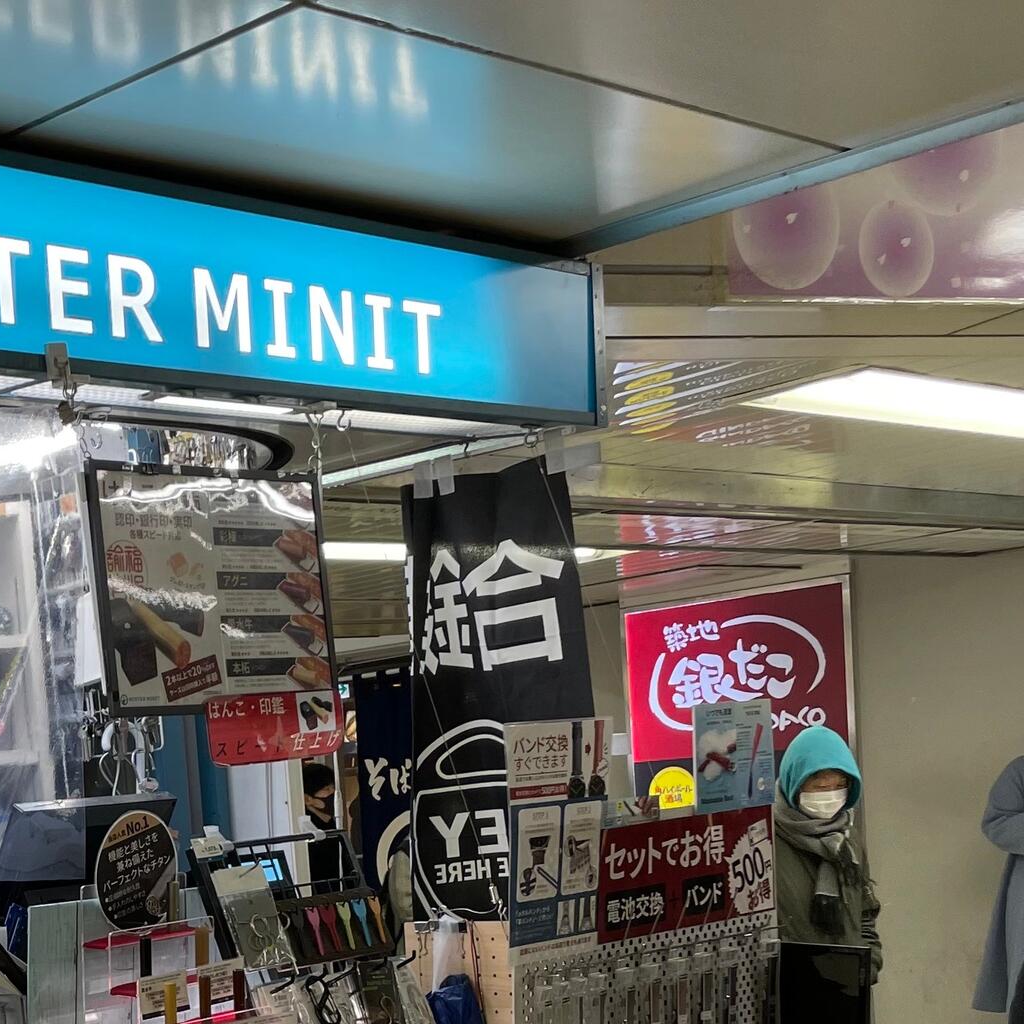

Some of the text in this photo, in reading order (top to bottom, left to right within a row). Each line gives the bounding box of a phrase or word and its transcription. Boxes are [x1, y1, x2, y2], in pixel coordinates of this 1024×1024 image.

[193, 267, 442, 376] MINIT
[663, 620, 720, 653] 築地
[667, 638, 796, 709] 銀だこ
[208, 696, 285, 719] はんこ・印鑑
[513, 734, 568, 754] バンド交換
[364, 757, 412, 800] そば
[514, 755, 568, 771] すぐできます
[605, 825, 725, 880] セットでお得
[607, 892, 664, 923] 電池交換
[686, 881, 724, 908] バンド
[747, 878, 772, 910] お得
